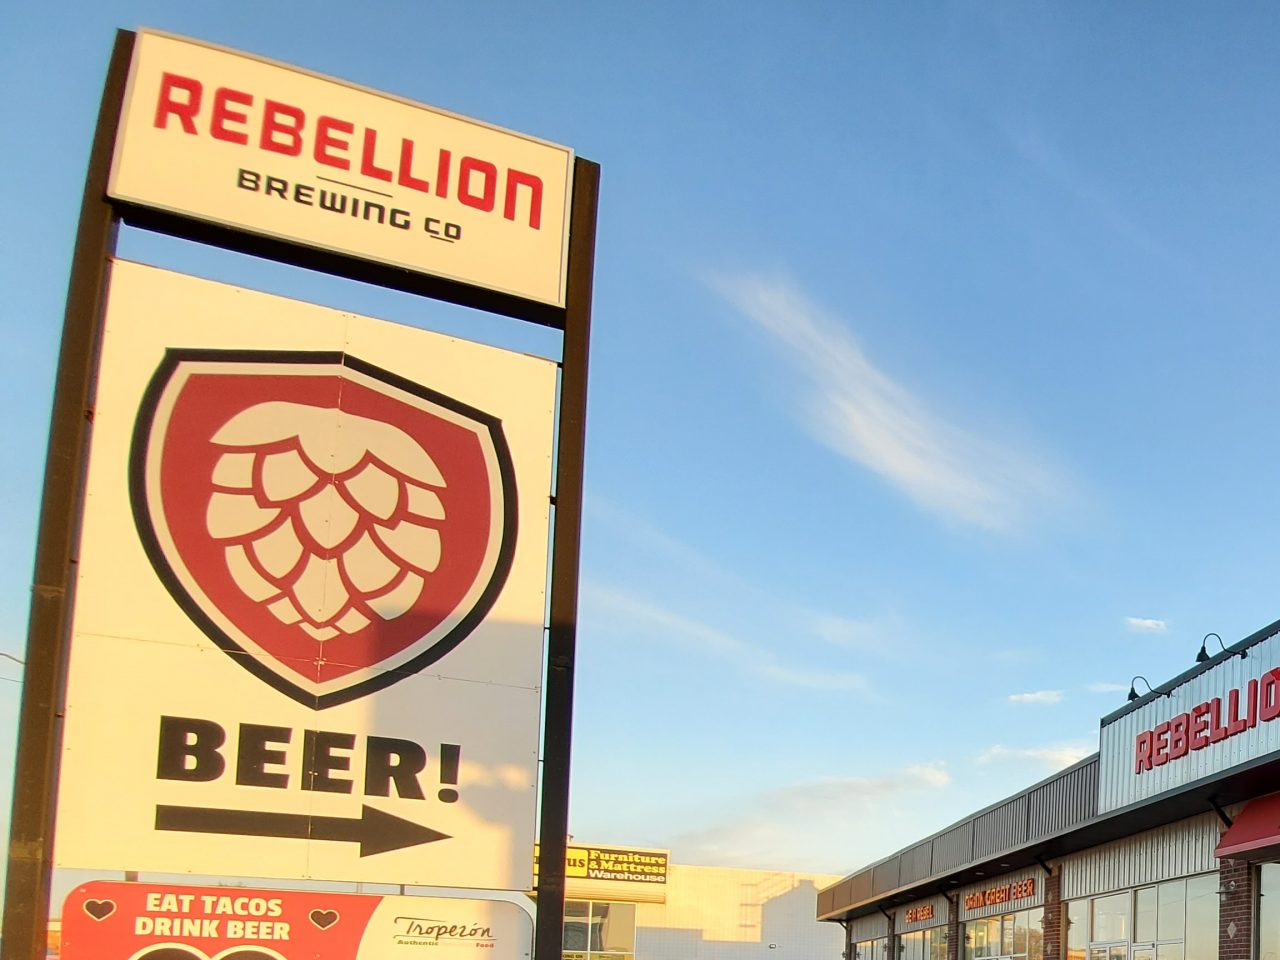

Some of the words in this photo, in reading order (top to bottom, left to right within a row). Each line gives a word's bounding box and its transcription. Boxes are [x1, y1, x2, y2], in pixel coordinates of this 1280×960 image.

[153, 71, 543, 230] REBELLION
[236, 168, 411, 231] BREWING
[424, 216, 462, 241] CO
[155, 714, 461, 804] BEER!
[588, 850, 666, 865] Furniture
[588, 860, 599, 869] &
[600, 860, 666, 874] Mattress
[588, 869, 666, 882] Warehouse
[986, 884, 1010, 905] GREAT
[1010, 878, 1034, 900] BEER
[146, 892, 195, 913] EAT
[201, 895, 283, 917] TACOS
[134, 916, 221, 938] DRINK
[226, 920, 290, 941] BEER
